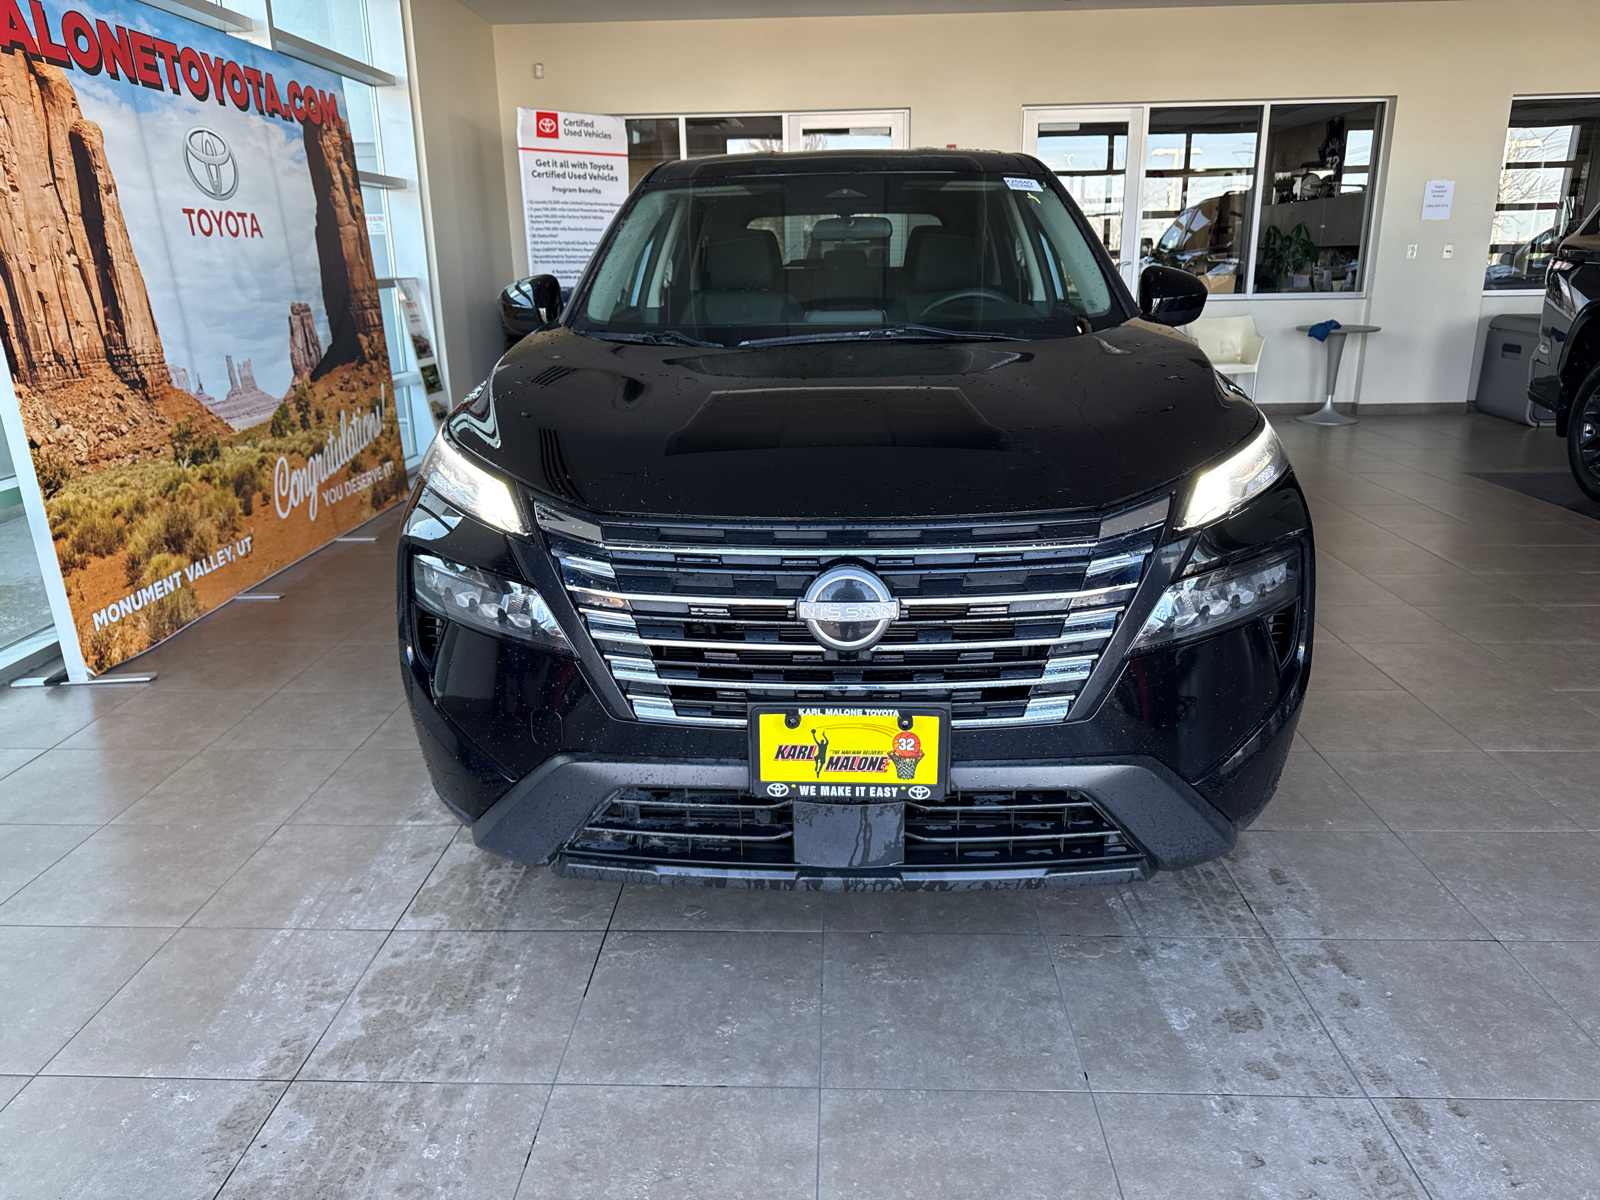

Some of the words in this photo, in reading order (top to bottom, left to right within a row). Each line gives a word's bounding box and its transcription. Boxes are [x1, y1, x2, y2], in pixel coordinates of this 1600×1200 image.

[563, 118, 595, 128] Certified
[563, 128, 582, 138] Used
[584, 130, 612, 140] Vehicles
[535, 158, 551, 167] Get
[552, 159, 557, 168] it
[559, 159, 570, 169] all
[571, 161, 588, 170] with
[590, 162, 614, 172] Toyota
[531, 170, 566, 180] Certified
[567, 171, 587, 181] Used
[588, 173, 619, 183] Vehicles
[552, 186, 577, 195] Program
[578, 187, 601, 195] Benefits
[182, 208, 264, 239] TOYOTA
[274, 383, 386, 521] Congratulations!
[322, 484, 343, 507] YOU
[344, 465, 384, 497] DESERVE
[383, 460, 395, 478] IT!
[92, 570, 182, 632] MONUMENT
[184, 545, 236, 583] VALLEY,
[235, 535, 252, 557] UT
[802, 605, 895, 618] NISSAN
[798, 708, 823, 716] KARL
[825, 708, 863, 717] MALONE
[865, 709, 900, 717] TOYOTA
[898, 738, 915, 751] 32
[774, 744, 818, 762] KARL
[824, 756, 890, 773] MALONE
[799, 785, 817, 796] WE
[820, 785, 852, 797] MAKE
[855, 786, 866, 797] IT
[870, 786, 898, 798] EASY
